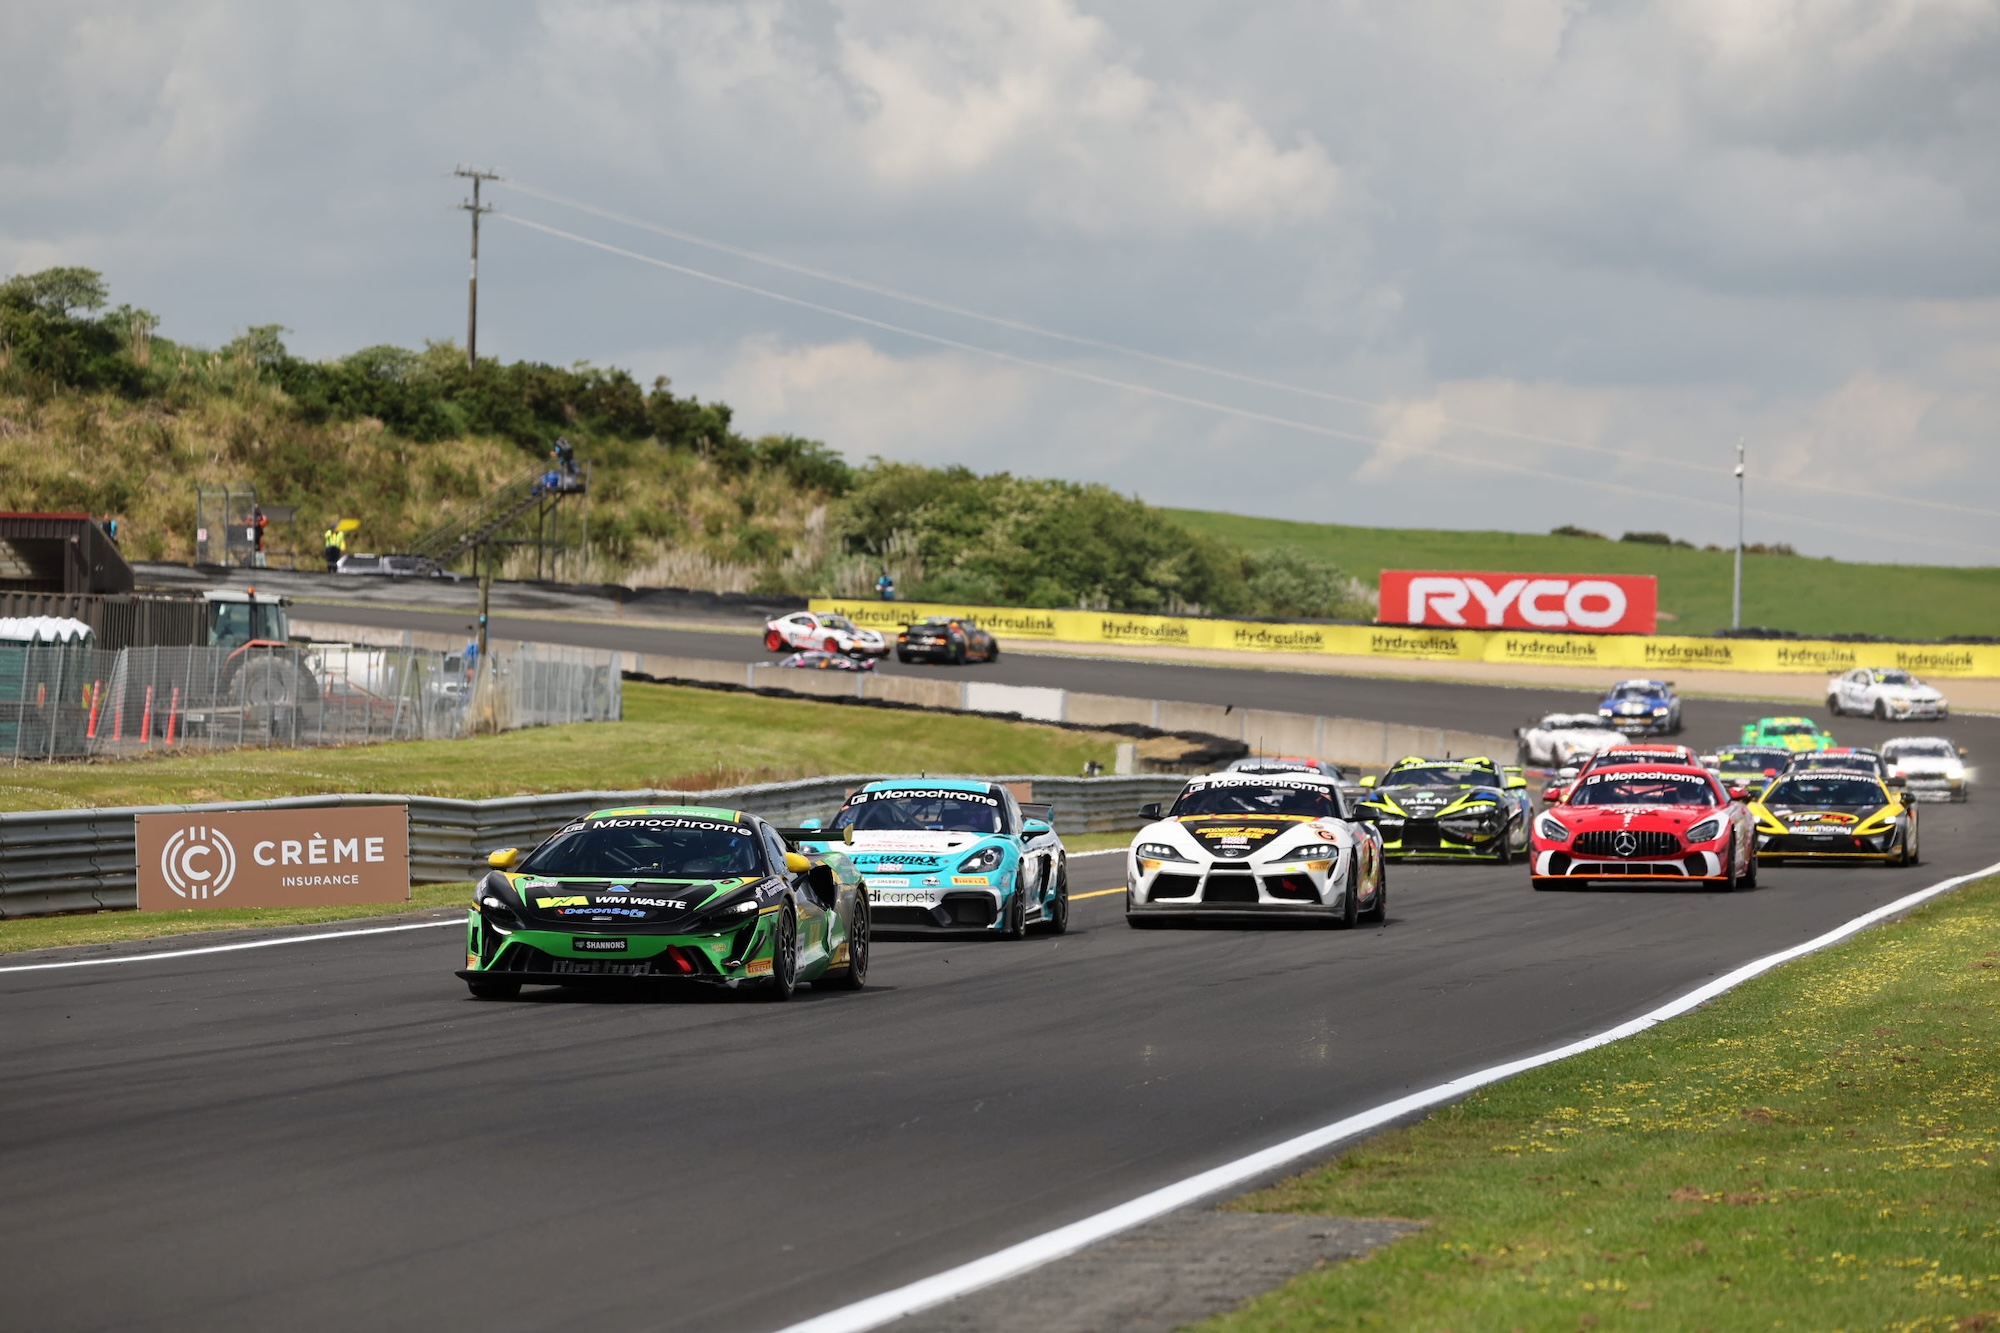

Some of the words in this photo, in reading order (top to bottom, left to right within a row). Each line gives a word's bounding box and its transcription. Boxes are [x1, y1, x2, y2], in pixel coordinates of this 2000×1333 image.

[1407, 577, 1627, 626] RYCO
[1101, 619, 1188, 637] Hydraulink
[1234, 629, 1323, 645] Hydraulink
[1371, 634, 1458, 650] Hydraulink
[1506, 639, 1597, 655] Hydraulink
[1645, 644, 1732, 658] Hydraulink
[1777, 647, 1856, 661] Hydraulink
[1897, 652, 1973, 665] Hydraulink
[1604, 771, 1705, 785] Monochrome
[1211, 780, 1329, 794] Monochrome
[873, 789, 998, 807] Monochrome
[593, 818, 753, 836] Monochrome
[253, 832, 385, 866] CRÈME
[282, 874, 359, 887] INSURANCE
[595, 896, 627, 904] WM
[630, 897, 688, 909] WASTE
[883, 890, 935, 903] carpets
[586, 941, 625, 949] SHANNONS
